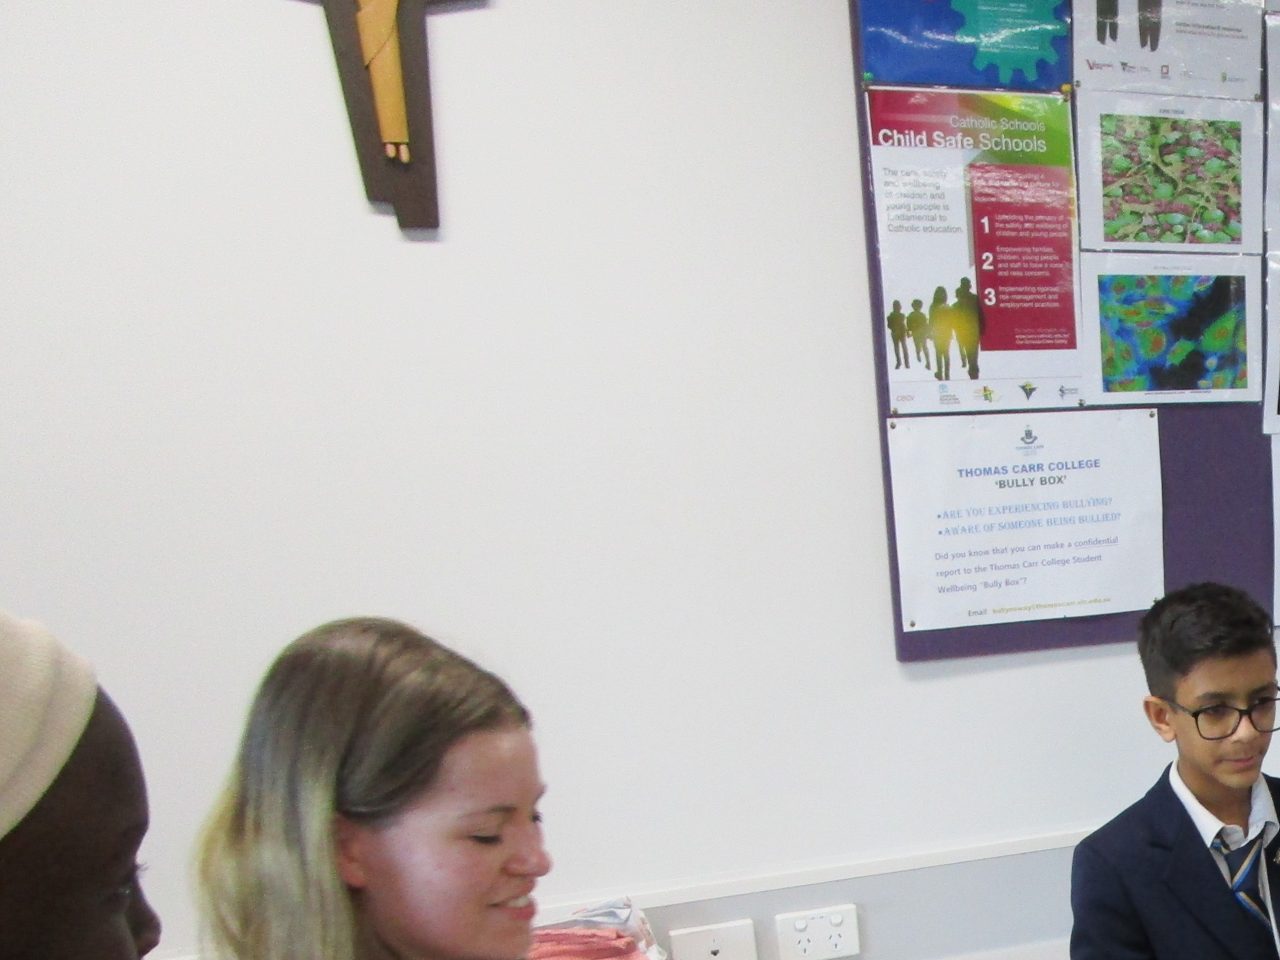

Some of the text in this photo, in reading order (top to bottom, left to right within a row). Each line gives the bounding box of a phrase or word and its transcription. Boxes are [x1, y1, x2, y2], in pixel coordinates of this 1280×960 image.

[950, 115, 1045, 131] Catholic Schools
[878, 129, 1046, 152] Child Safe Schools
[939, 214, 948, 222] to
[980, 216, 990, 234] 1
[888, 223, 920, 232] Catholic
[982, 252, 995, 270] 2
[984, 288, 997, 306] 3
[958, 459, 1100, 478] THOMAS CARR COLLEGE
[942, 496, 1113, 520] ARE YOU EXPERIENCING BULLYING?
[944, 512, 1122, 536] AWARE OF SOMEONE BEING BULLIED?
[935, 552, 949, 561] Did
[951, 552, 966, 560] you
[968, 548, 990, 557] know
[992, 546, 1008, 555] that
[1010, 546, 1026, 555] you
[1027, 544, 1042, 552] can
[1044, 541, 1065, 550] make
[1074, 536, 1120, 548] confidential
[936, 554, 1103, 578] report to the Thomas Carr College Student
[938, 584, 978, 594] Wellbeing
